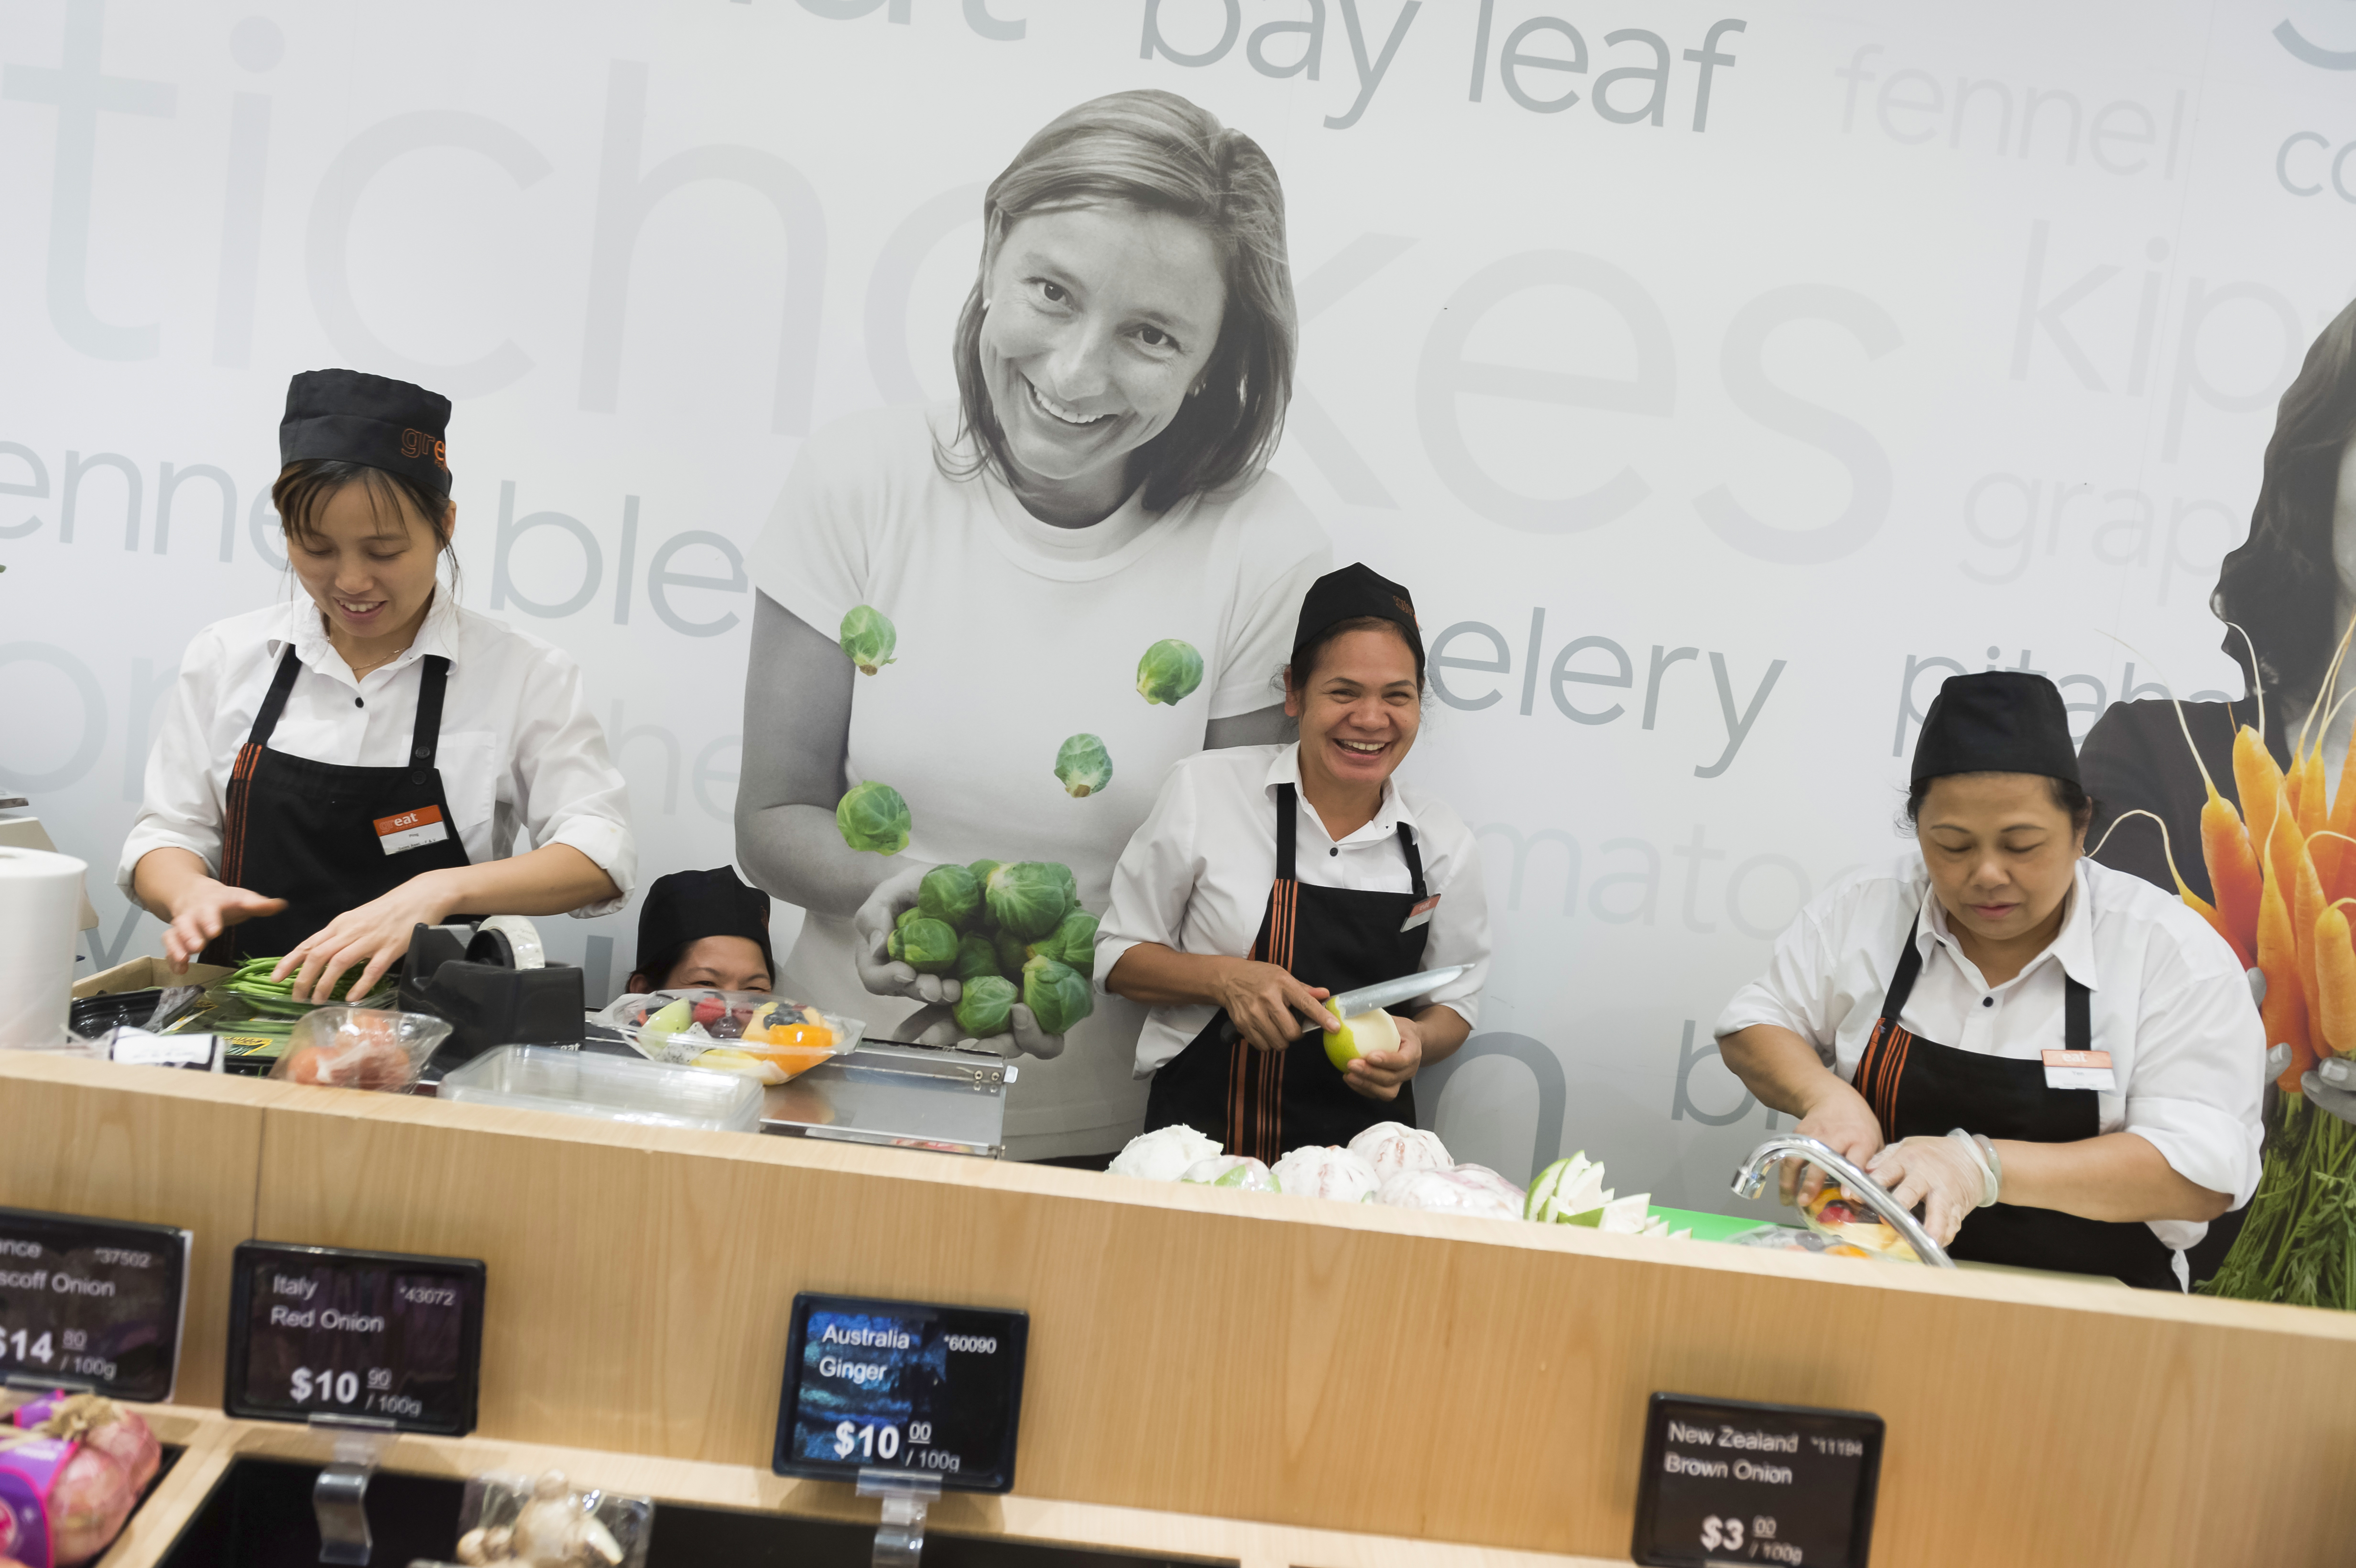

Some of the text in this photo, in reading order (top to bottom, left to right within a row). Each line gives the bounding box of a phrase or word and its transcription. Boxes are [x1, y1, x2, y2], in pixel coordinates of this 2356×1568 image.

[1468, 0, 1748, 133] leaf
[1834, 43, 2187, 181] fennel
[2009, 218, 2356, 465] kip
[489, 479, 749, 638] ble
[1416, 606, 1789, 779] elery
[52, 1272, 115, 1296] Onion
[273, 1273, 318, 1300] Italy
[271, 1304, 385, 1333] Red Onion
[822, 1323, 910, 1350] Australia
[74, 1355, 117, 1381] 100g
[819, 1354, 888, 1384] Ginger
[290, 1367, 359, 1404] $10
[379, 1395, 423, 1417] 100g
[833, 1420, 932, 1459] $10 00
[1668, 1419, 1800, 1454] New Zealand
[919, 1449, 961, 1473] 100g
[1664, 1451, 1793, 1485] Brown Onion
[1700, 1514, 1745, 1552] $3
[1762, 1541, 1803, 1567] 100g
